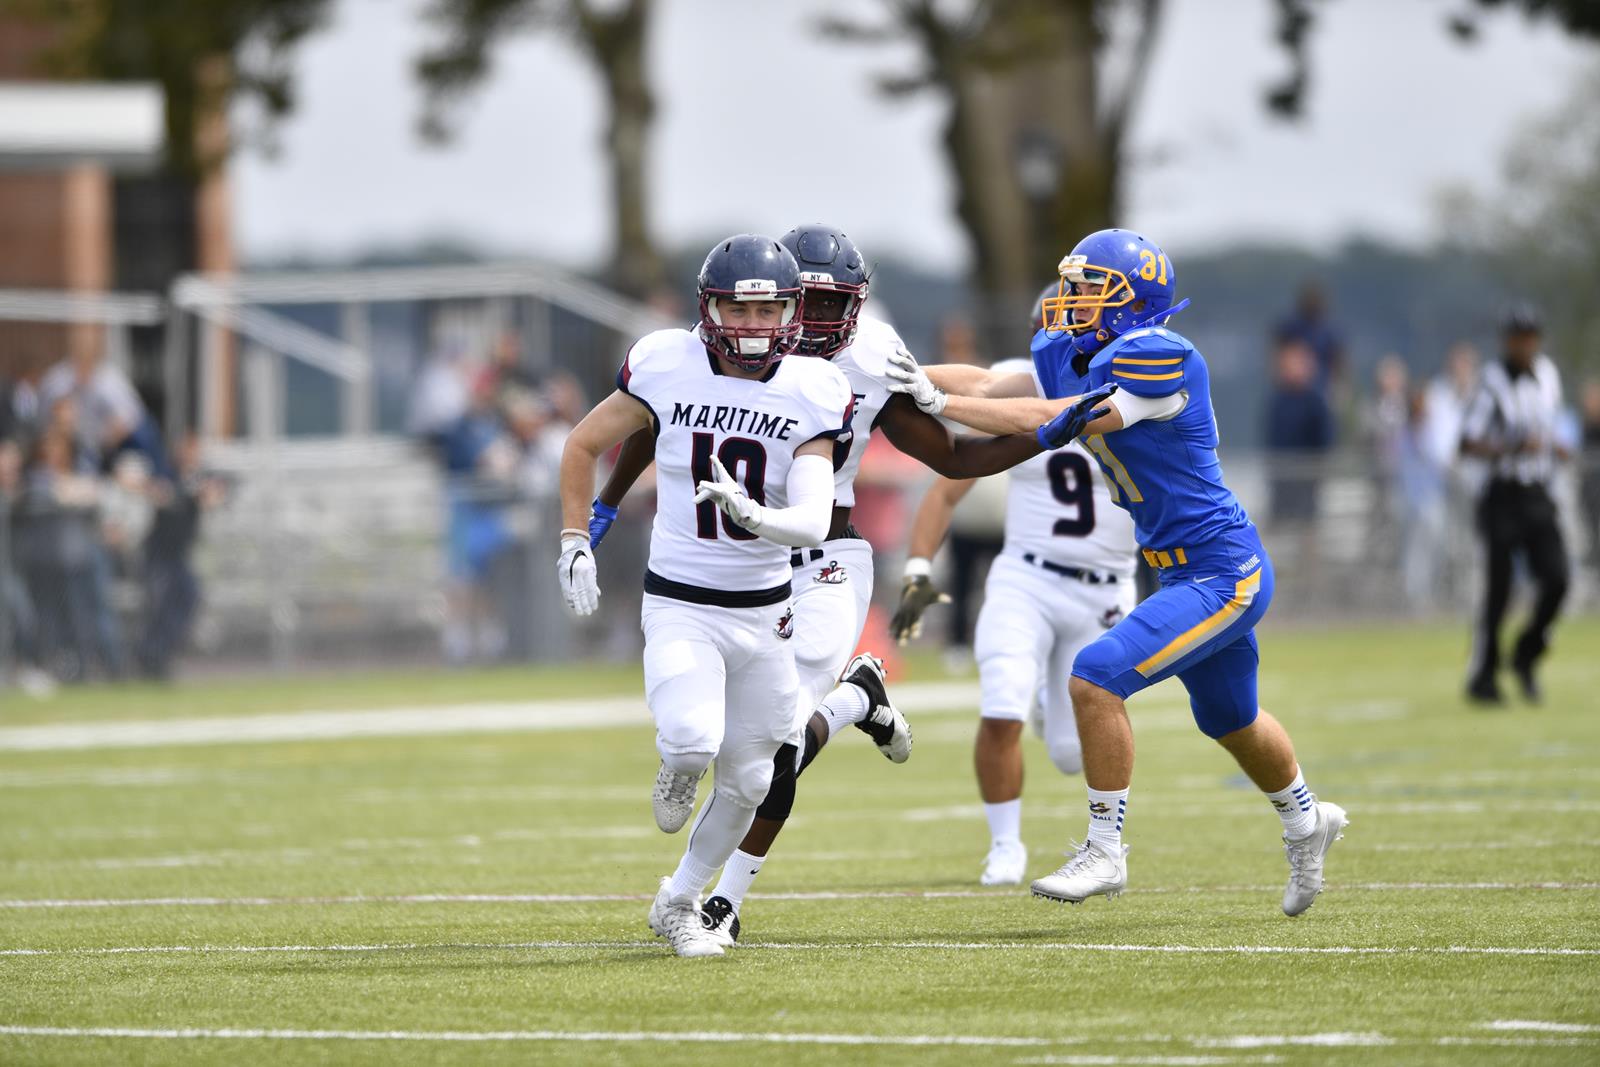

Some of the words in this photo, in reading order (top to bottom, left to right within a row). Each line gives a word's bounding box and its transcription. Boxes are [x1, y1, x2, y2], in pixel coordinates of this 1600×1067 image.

[1139, 248, 1167, 286] 31
[671, 402, 799, 440] MARITIME
[691, 432, 767, 540] 10
[1047, 452, 1095, 538] 9
[1075, 430, 1144, 502] 1
